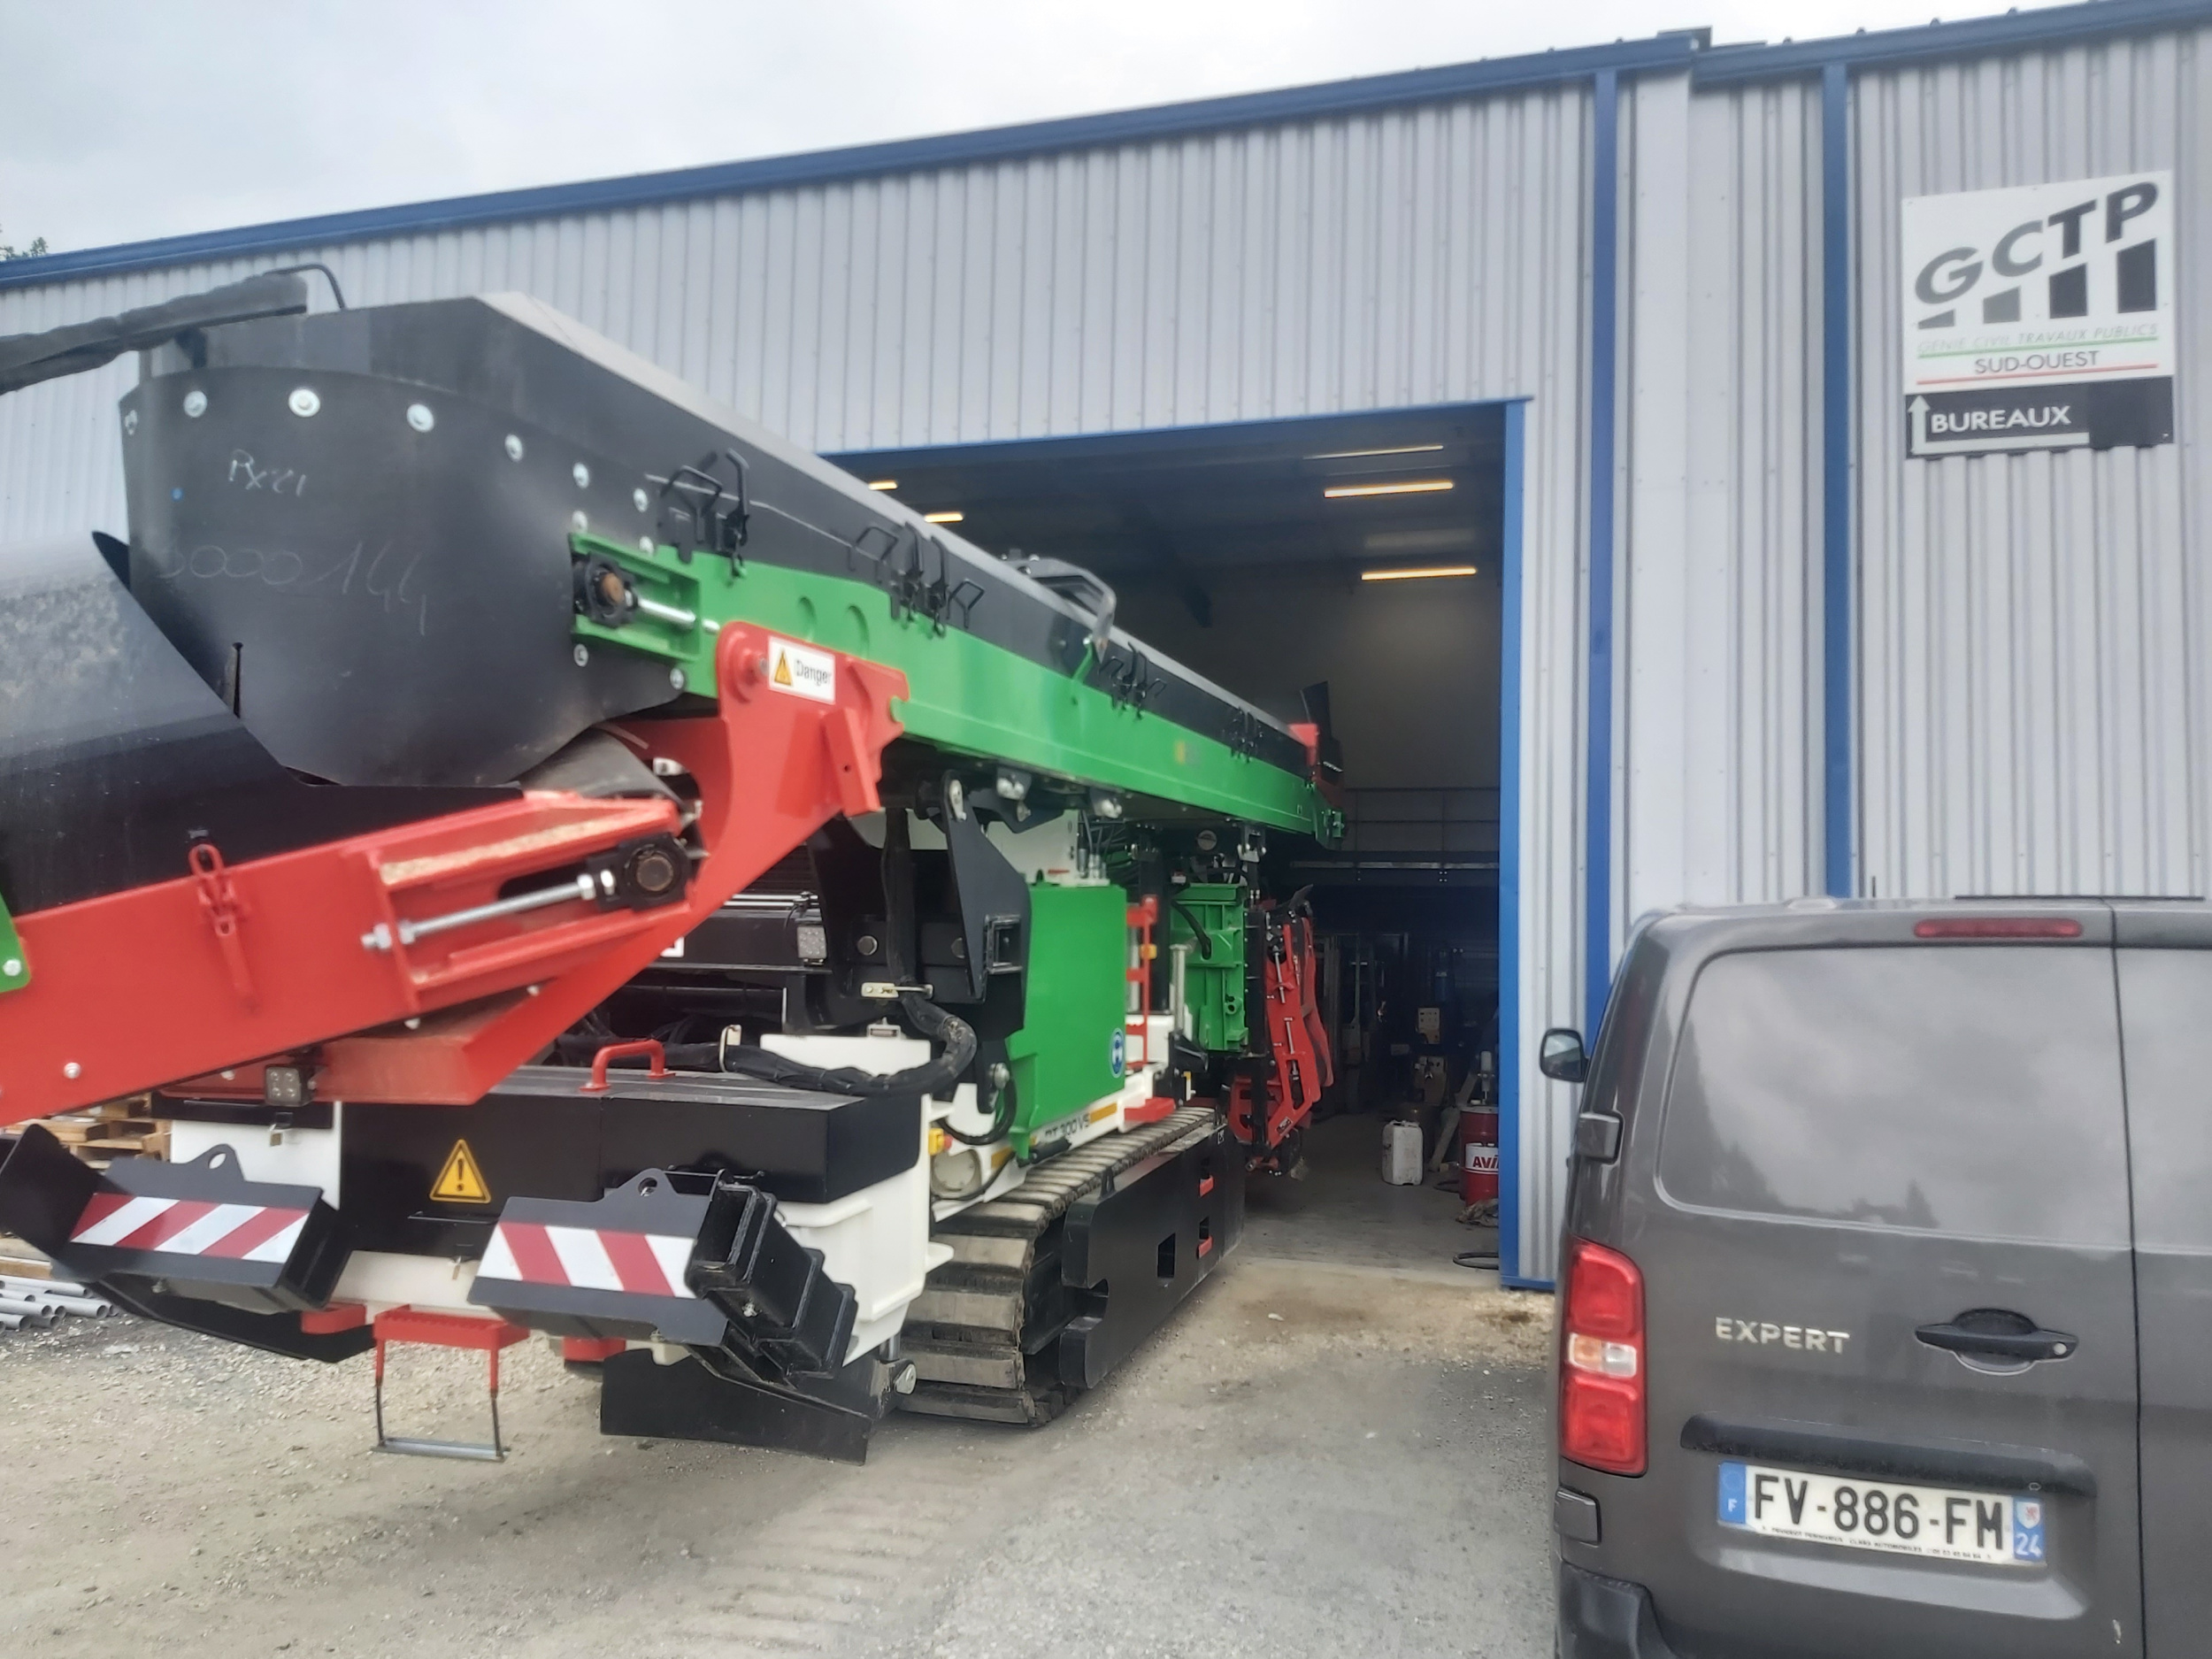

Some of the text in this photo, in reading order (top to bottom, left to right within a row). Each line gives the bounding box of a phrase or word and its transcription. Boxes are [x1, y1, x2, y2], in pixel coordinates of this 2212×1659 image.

[1915, 181, 2159, 304] GCTP
[2018, 329, 2088, 344] TRAVAUX
[2093, 323, 2158, 338] PUBLICS
[1974, 350, 2100, 374] SUD-OUEST
[1931, 405, 2071, 434] BUREAUX
[795, 659, 832, 686] Danger
[1472, 1155, 1499, 1169] AVI
[1716, 1317, 1850, 1354] EXPERT
[1727, 1498, 1738, 1512] F
[1755, 1474, 2003, 1550] FV-886-FM
[2016, 1532, 2043, 1557] 24
